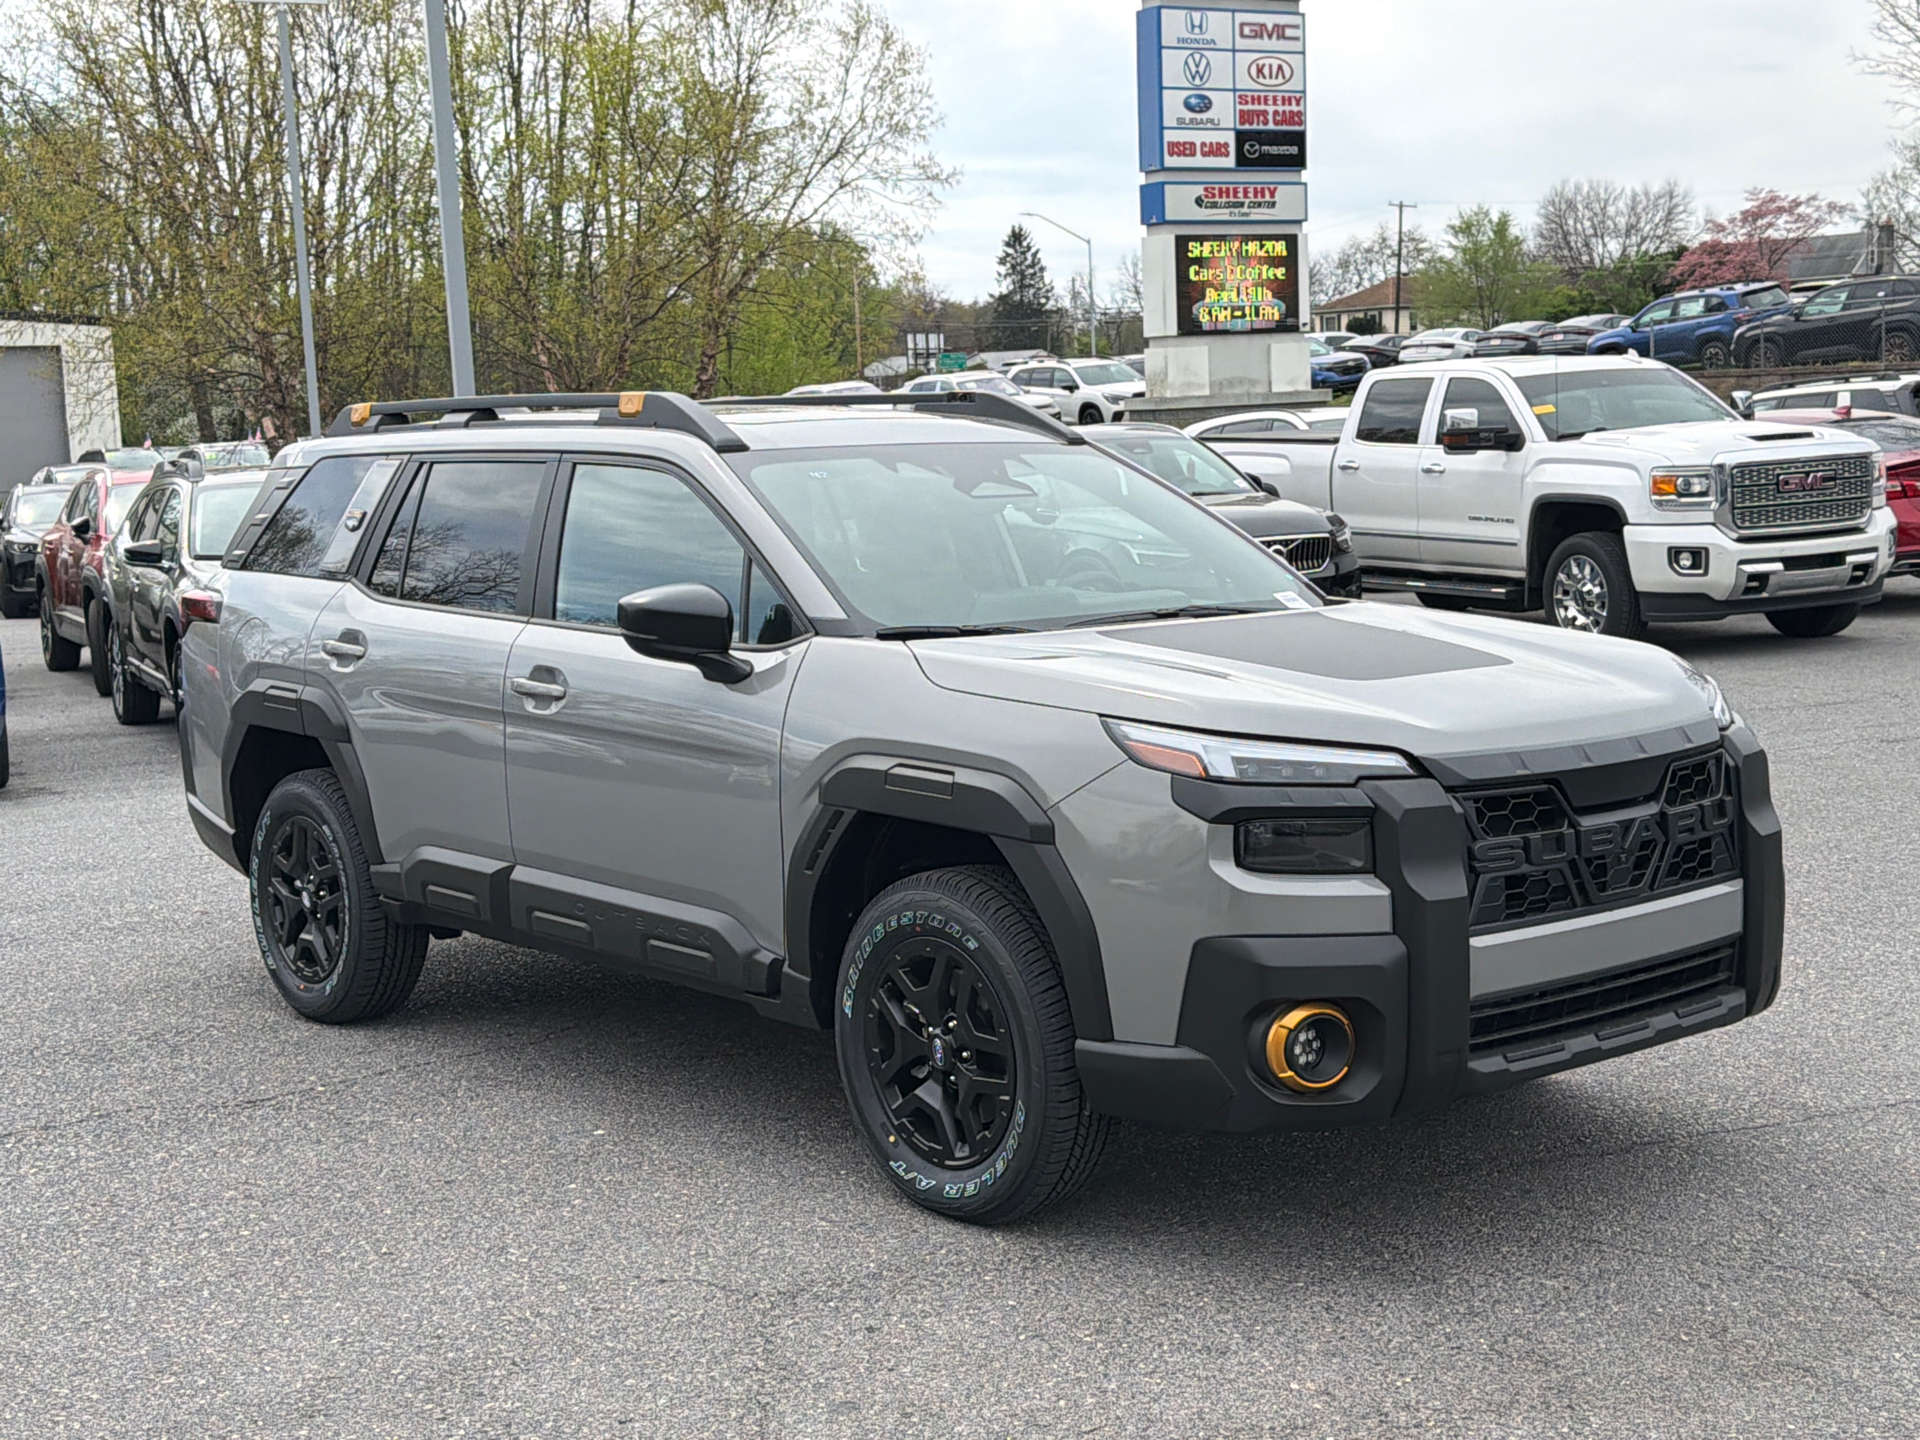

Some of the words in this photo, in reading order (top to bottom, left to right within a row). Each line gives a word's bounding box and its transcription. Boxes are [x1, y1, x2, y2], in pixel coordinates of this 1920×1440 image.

[1239, 22, 1301, 41] GMC
[1176, 36, 1217, 46] HONDA
[1256, 63, 1287, 80] KIA
[1238, 94, 1303, 107] SHEEHY
[1176, 117, 1220, 127] SUBARU
[1239, 109, 1269, 127] BUYS
[1272, 109, 1303, 127] CARS
[1167, 141, 1197, 157] USED
[1200, 141, 1230, 158] CARS
[1203, 186, 1278, 200] SHEEHY
[1203, 200, 1246, 209] COLLISION
[1247, 200, 1277, 209] CENTER
[1187, 240, 1240, 258] SHEEHY
[1189, 265, 1224, 281] Cars
[1236, 264, 1287, 280] Coffee
[1205, 287, 1239, 303] April
[1779, 471, 1836, 492] GMC
[1471, 795, 1734, 872] SUBARU
[574, 903, 711, 945] OUTBACK
[842, 910, 980, 1018] BRIDGESTONE
[943, 1099, 1026, 1198] DUELER
[889, 1160, 937, 1191] A/T
